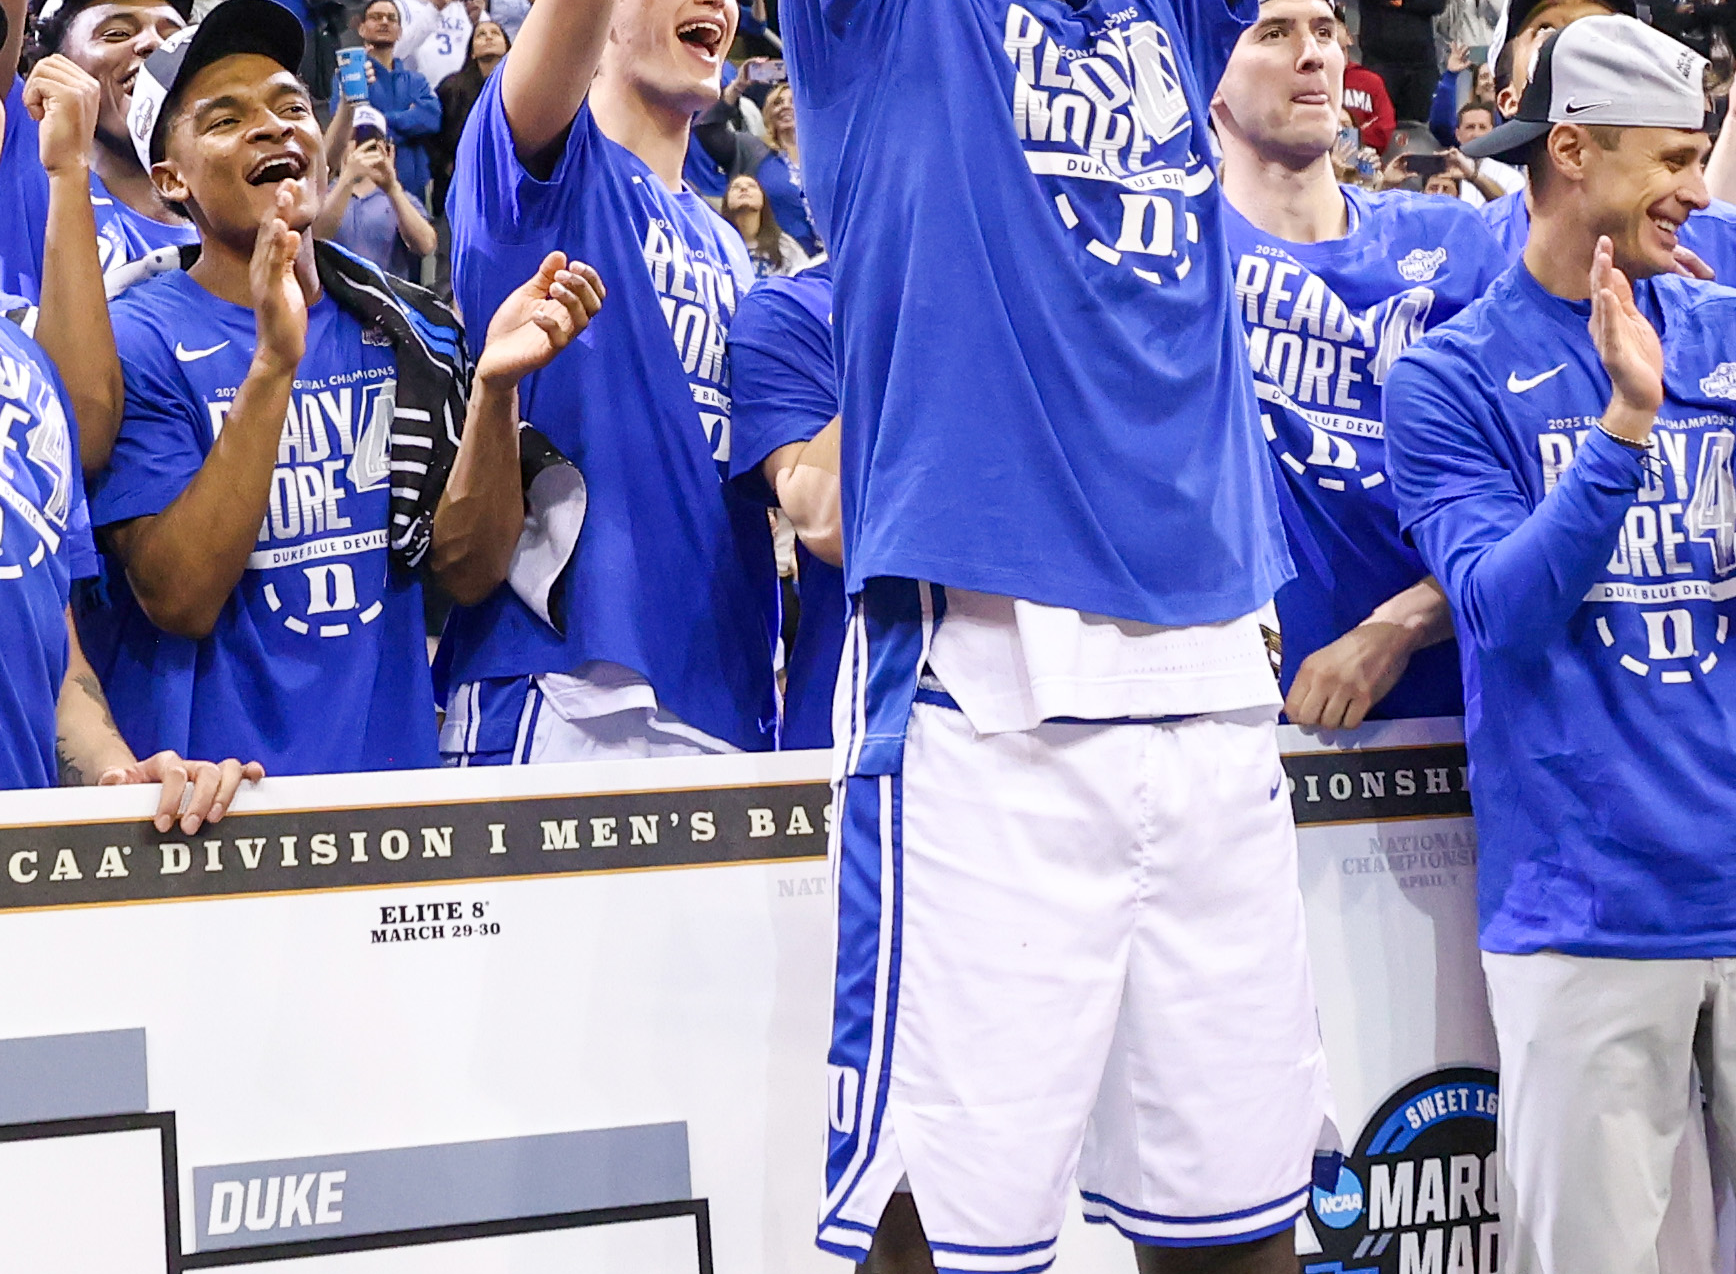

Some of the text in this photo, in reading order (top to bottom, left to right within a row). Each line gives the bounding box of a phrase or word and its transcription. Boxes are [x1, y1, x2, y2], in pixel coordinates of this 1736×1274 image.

[435, 34, 452, 55] 3
[1235, 254, 1377, 347] READY
[1346, 420, 1384, 437] DEVI
[1548, 416, 1581, 430] 2025
[259, 460, 352, 542] ORE
[273, 547, 304, 564] DUKE
[307, 541, 338, 557] BLUE
[1641, 584, 1677, 600] BLUE
[160, 823, 455, 877] DIVISION
[488, 823, 507, 855] I
[541, 810, 717, 852] MEN'S
[380, 903, 464, 925] ELITE
[370, 921, 501, 945] MARCH 29-30
[1405, 1088, 1470, 1130] SWEET
[207, 1170, 346, 1237] DUKE
[1319, 1193, 1364, 1217] NCAA
